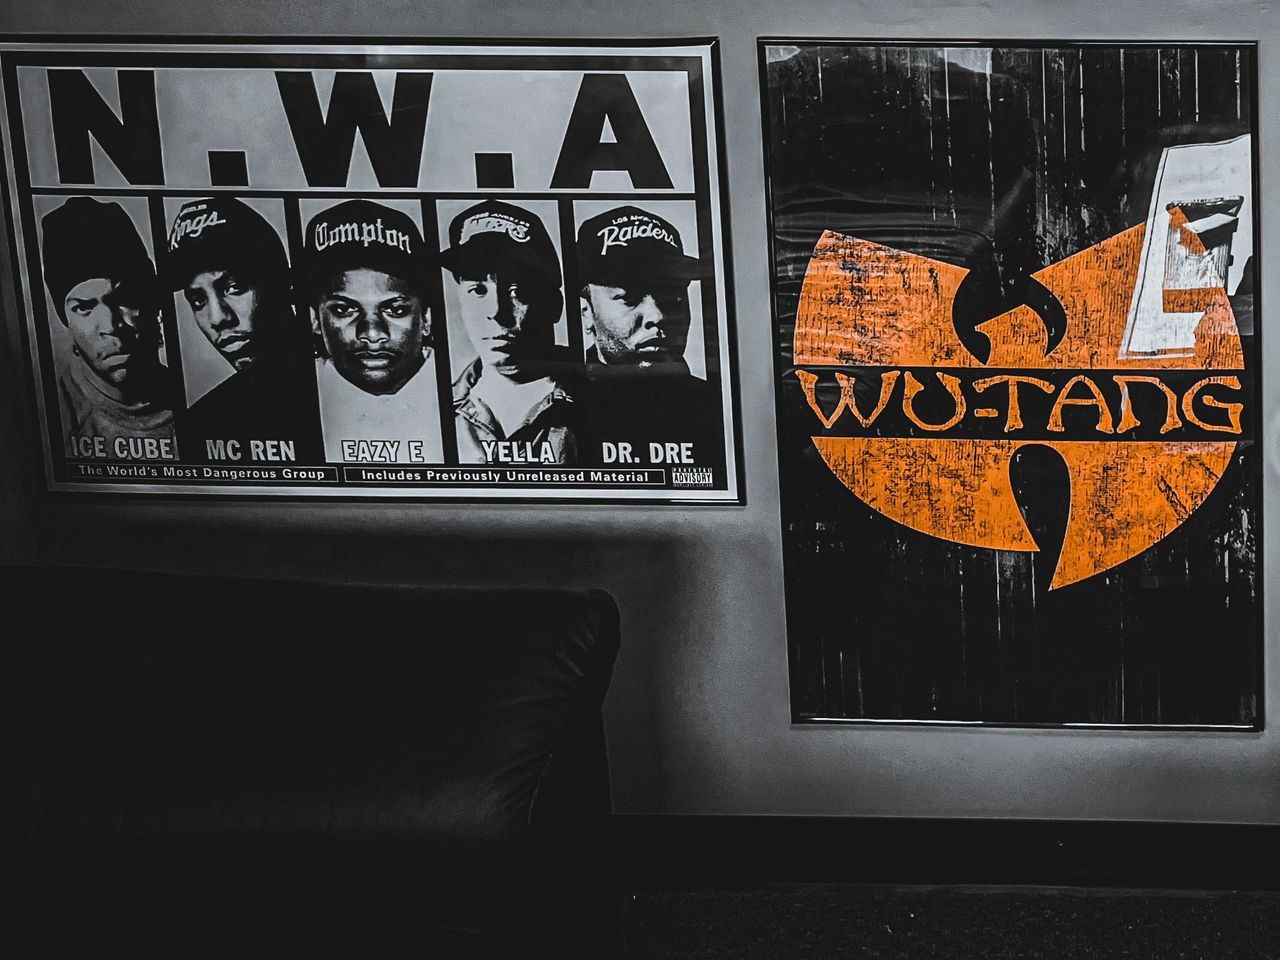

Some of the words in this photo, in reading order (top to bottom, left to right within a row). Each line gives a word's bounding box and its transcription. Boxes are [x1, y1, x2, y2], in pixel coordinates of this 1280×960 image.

[314, 218, 412, 255] Compton
[597, 220, 678, 256] Raiders
[795, 370, 1243, 434] WU-TANG
[70, 436, 107, 458] ICE
[114, 437, 174, 460] CUBE
[206, 439, 242, 461] MC
[250, 440, 296, 461] REN
[342, 440, 401, 462] EAZY
[407, 440, 424, 462] E
[481, 440, 556, 464] YELLA
[602, 441, 641, 464] DR.
[650, 442, 695, 464] DRE
[79, 464, 103, 475] The
[107, 465, 158, 477] World's
[163, 466, 198, 478] Most
[203, 467, 277, 480] Dangerous
[282, 468, 325, 481] Group
[361, 470, 421, 482] Includes
[426, 470, 500, 484] Previously
[506, 471, 585, 482] Unreleased
[590, 472, 649, 483] Material
[674, 473, 711, 483] ADVISORY
